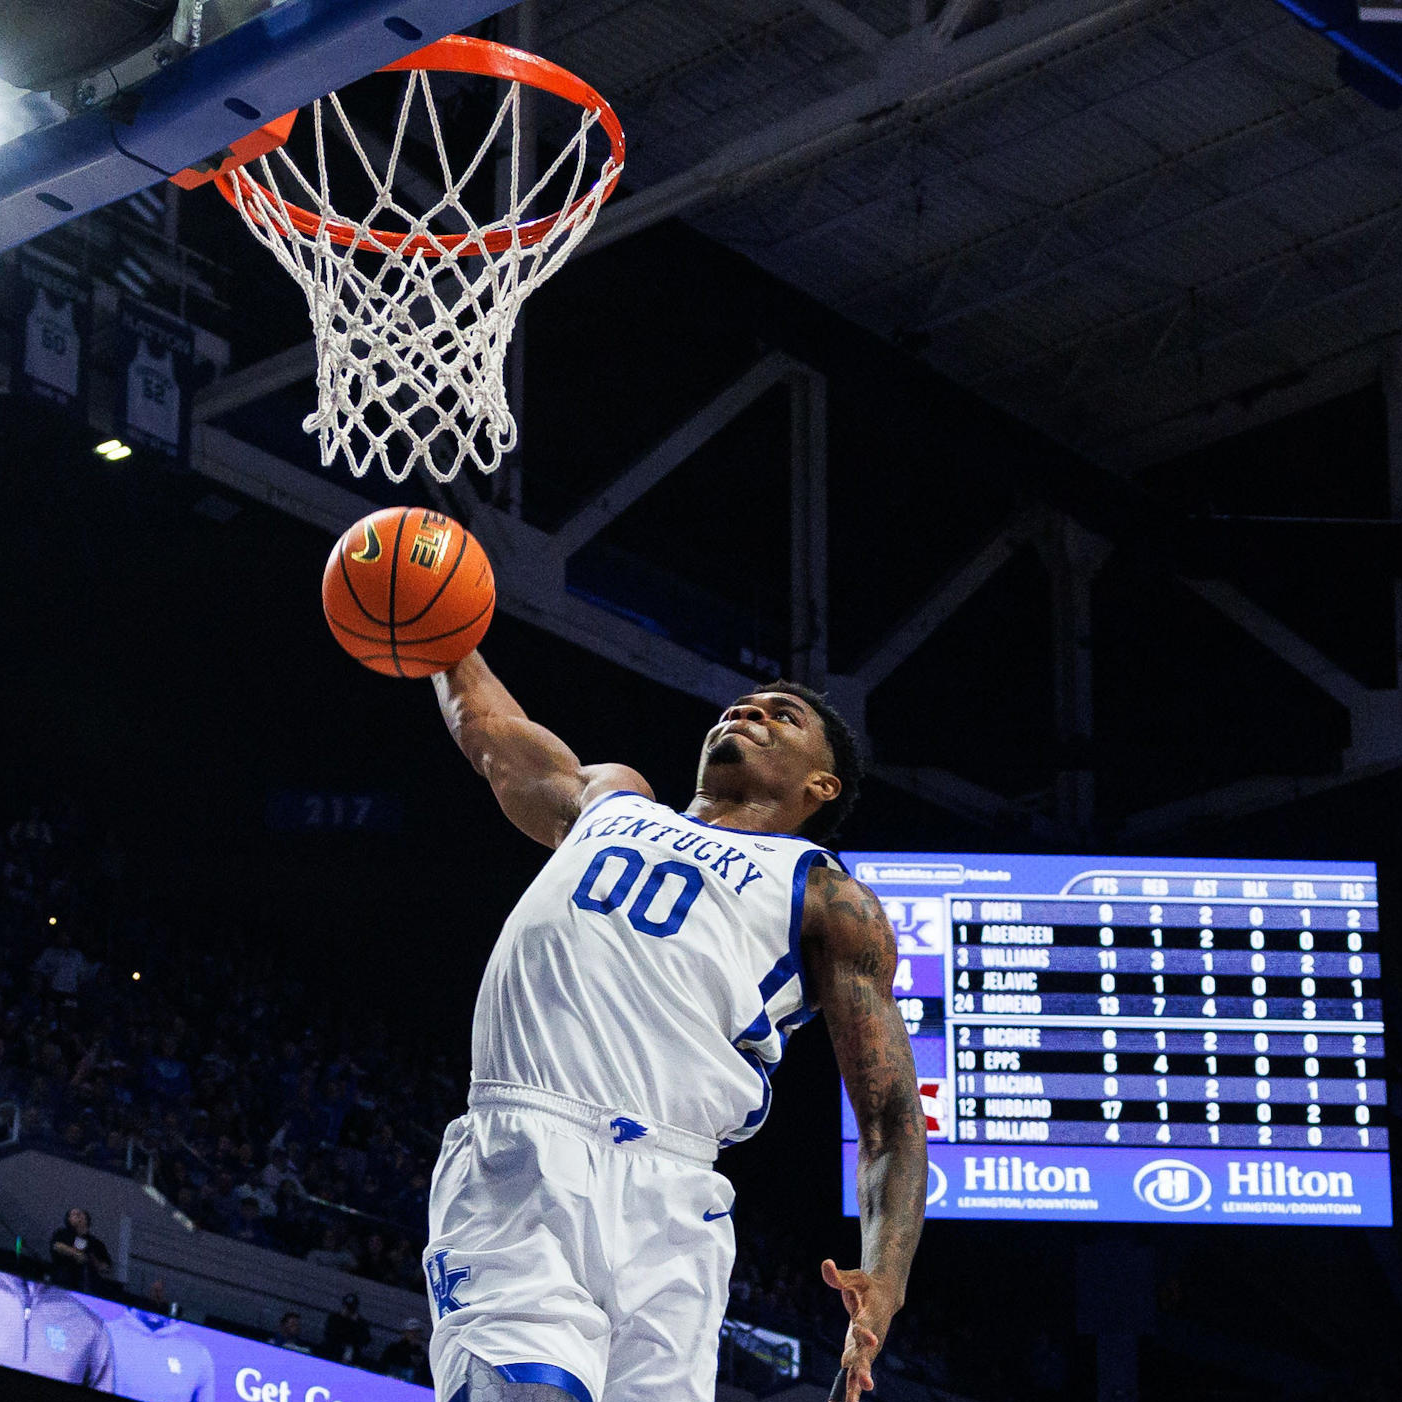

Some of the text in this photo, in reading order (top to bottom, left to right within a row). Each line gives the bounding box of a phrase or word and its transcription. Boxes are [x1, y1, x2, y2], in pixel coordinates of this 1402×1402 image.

[574, 816, 763, 896] KENTUCKY
[572, 846, 705, 938] 00
[952, 901, 973, 921] 00
[1149, 904, 1163, 924] 2
[1199, 905, 1213, 925] 2
[1347, 909, 1361, 929] 2
[959, 925, 968, 943] 1
[981, 925, 1053, 944] ABERDEEN
[1152, 928, 1162, 946] 1
[1200, 929, 1214, 948] 2
[957, 948, 1213, 971] 3 WILLIAMS 11 3 1
[958, 971, 1362, 997] 4 JELAVIC 0 1 0 1
[954, 994, 974, 1013] 24
[982, 995, 1042, 1013] MORENO
[1152, 997, 1166, 1016] 7
[1202, 998, 1217, 1017] 4
[1352, 1001, 1363, 1020] 1
[959, 1027, 971, 1046] 2
[1155, 1031, 1166, 1050] 1
[1204, 1031, 1217, 1051] 2
[1352, 1034, 1367, 1054] 2
[957, 1051, 976, 1070] 10
[984, 1051, 1020, 1070] EPPS
[1154, 1055, 1169, 1073] 4
[1206, 1056, 1217, 1074] 1
[1355, 1059, 1366, 1077] 1
[958, 1075, 1367, 1101] 11 MACURA 0 1 2 1
[958, 1098, 1220, 1122] 12 HUBBARD 17 1 3
[958, 1121, 1369, 1147] 15 BALLARD 4 4 1 1
[964, 1156, 1354, 1197] Hilton Hilton
